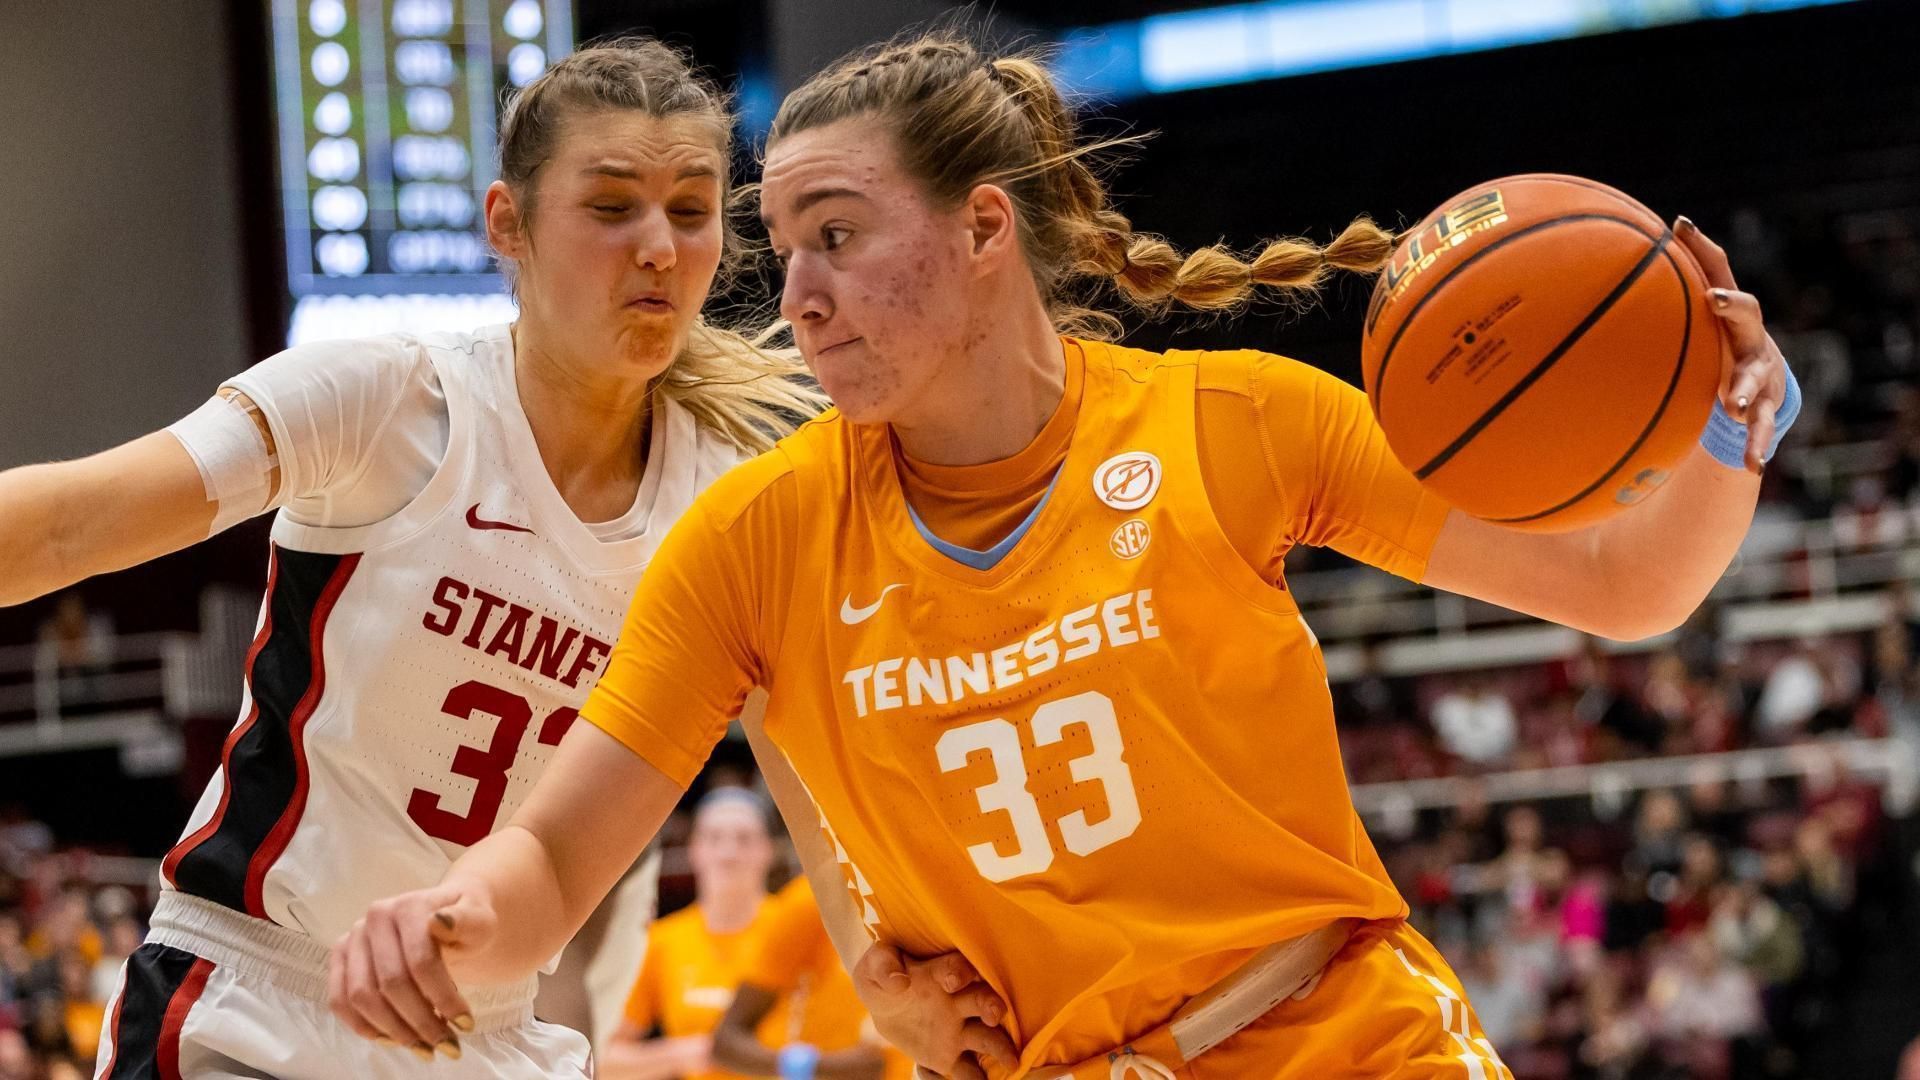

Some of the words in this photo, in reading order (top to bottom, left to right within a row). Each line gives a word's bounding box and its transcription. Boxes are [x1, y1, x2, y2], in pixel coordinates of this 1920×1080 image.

[1113, 521, 1148, 556] SEC
[422, 576, 612, 689] STANF
[843, 588, 1160, 718] TENNESSEE
[407, 680, 580, 848] 3
[935, 690, 1143, 884] 33
